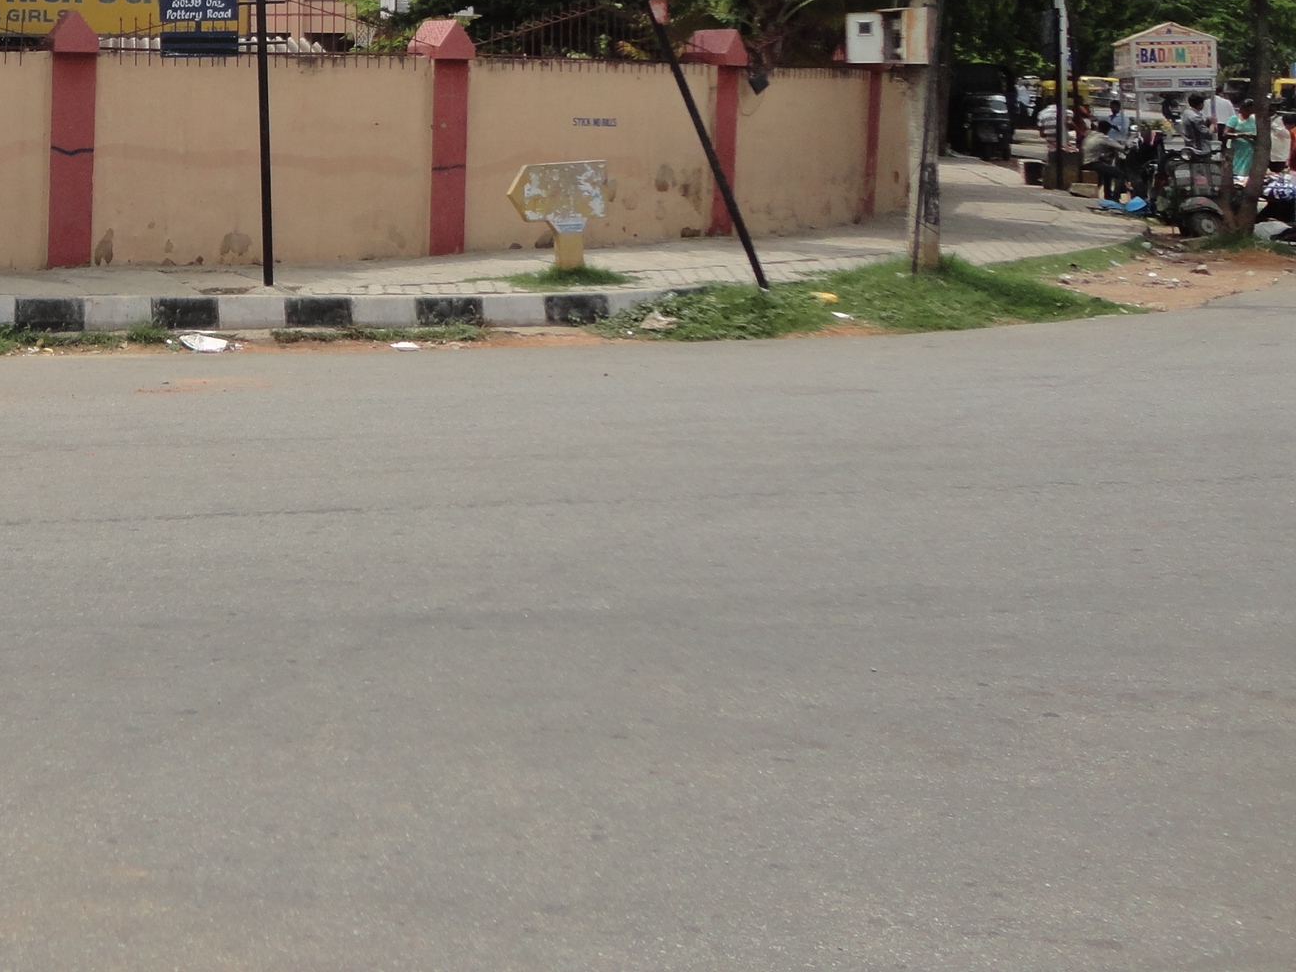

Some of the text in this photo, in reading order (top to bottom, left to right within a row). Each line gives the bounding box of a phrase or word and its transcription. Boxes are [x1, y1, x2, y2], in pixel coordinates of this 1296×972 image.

[166, 9, 232, 21] Pottery Road
[1140, 48, 1186, 63] BADAM
[572, 117, 592, 127] STICK
